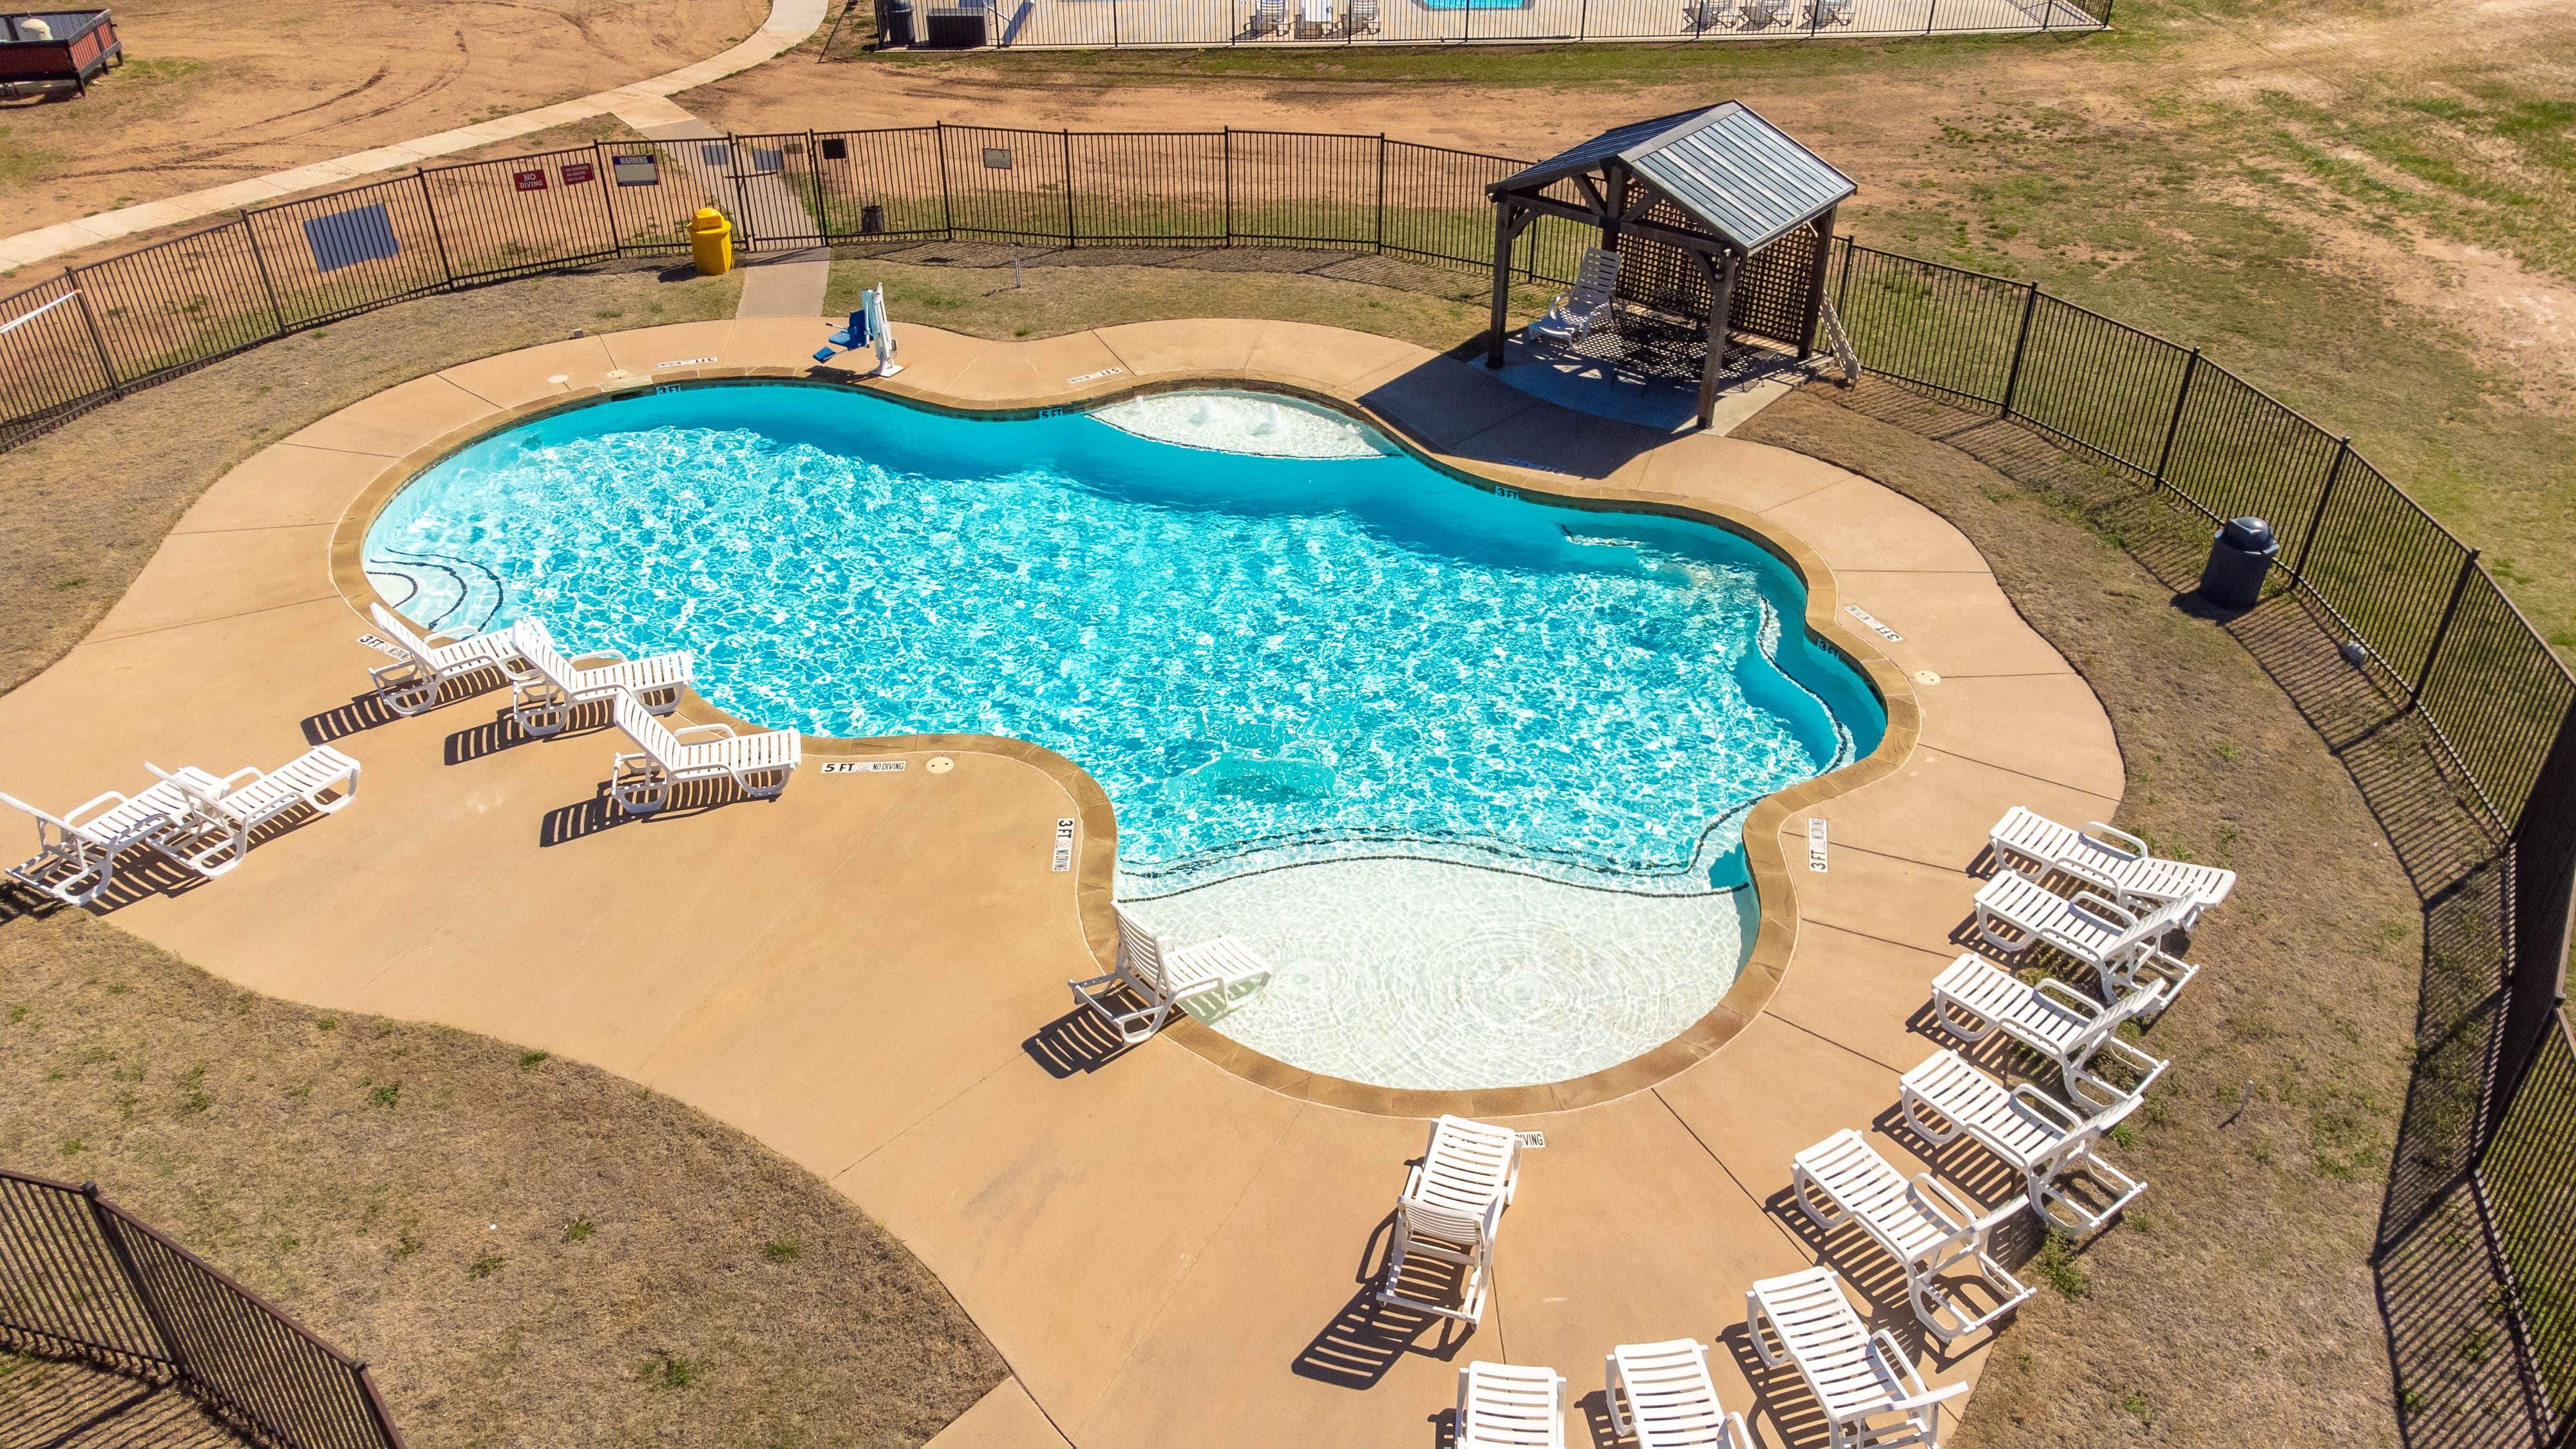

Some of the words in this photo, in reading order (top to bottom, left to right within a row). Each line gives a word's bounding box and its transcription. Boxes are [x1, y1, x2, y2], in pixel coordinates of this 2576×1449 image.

[668, 384, 681, 393] FT
[1052, 409, 1062, 417] FT
[1498, 488, 1505, 497] 3
[1507, 490, 1519, 499] FT
[367, 638, 384, 647] FT
[824, 763, 835, 772] 5
[839, 763, 855, 772] FT
[1057, 829, 1072, 838] FT
[1810, 849, 1825, 861] FT
[1515, 1133, 1543, 1146] VING
